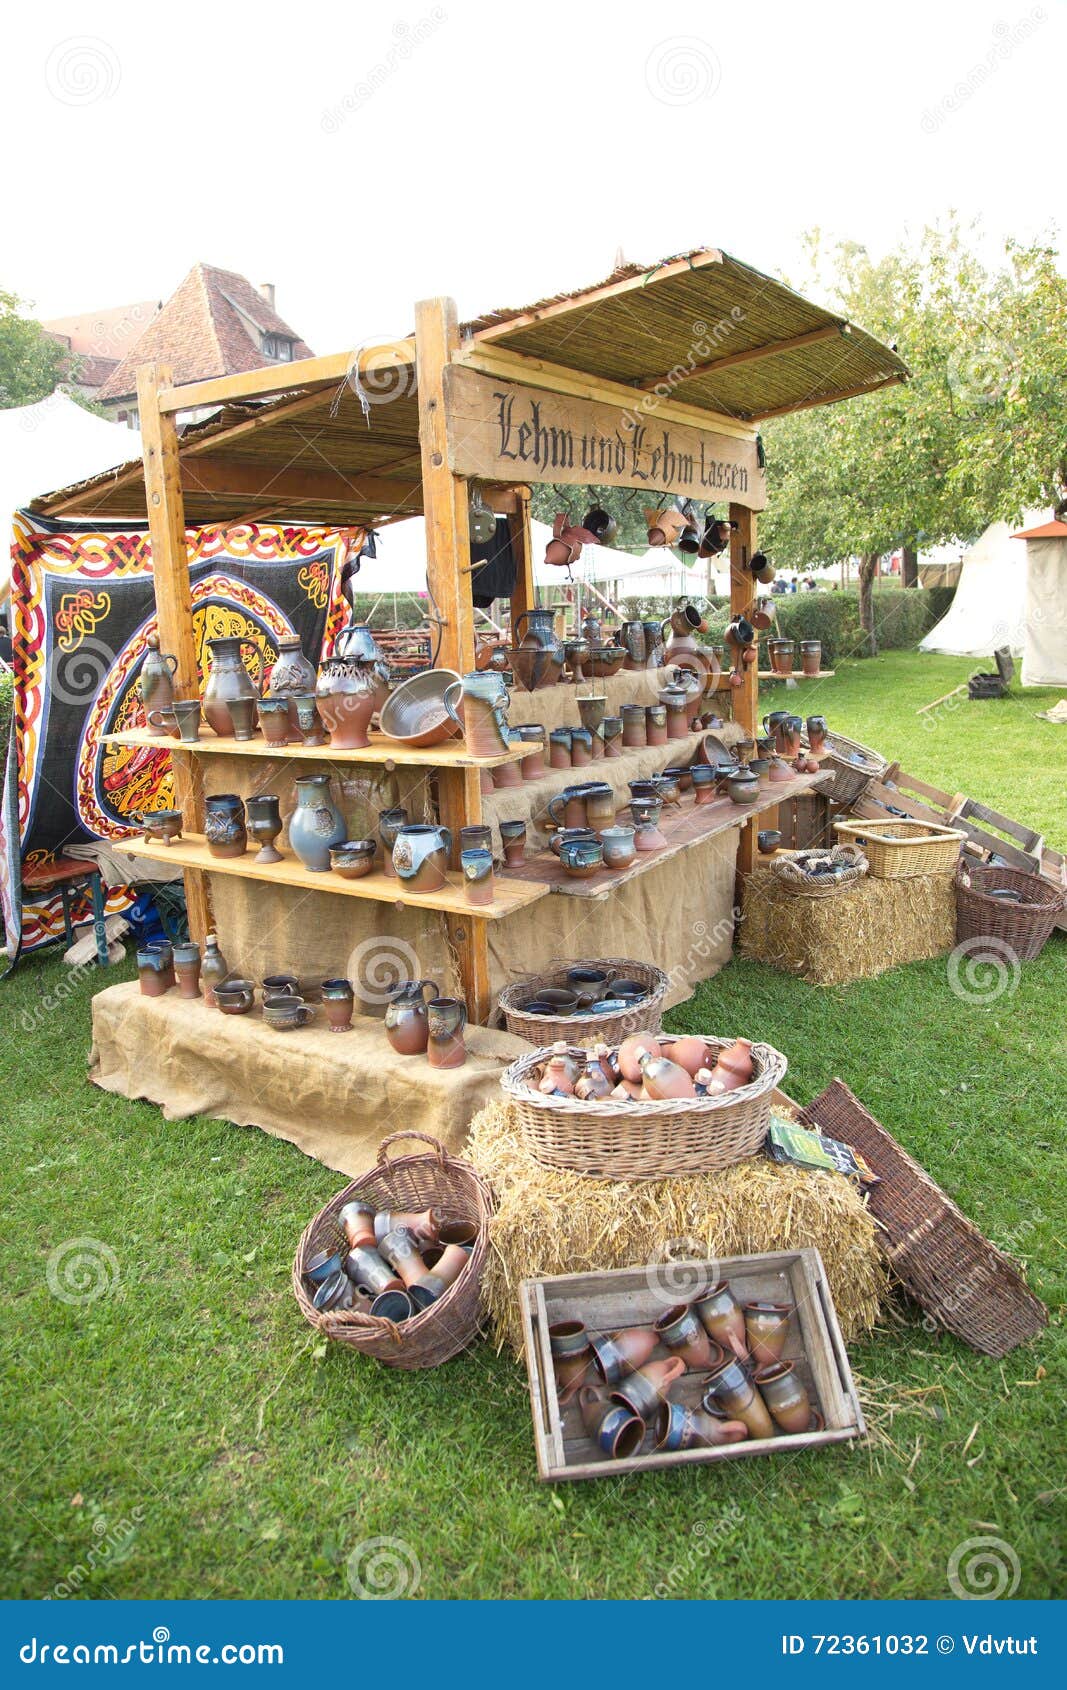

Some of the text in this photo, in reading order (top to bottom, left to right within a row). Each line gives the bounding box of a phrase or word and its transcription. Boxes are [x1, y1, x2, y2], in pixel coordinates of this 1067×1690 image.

[493, 392, 574, 474] Lehm
[581, 431, 626, 475] und
[629, 423, 693, 489] Lehm
